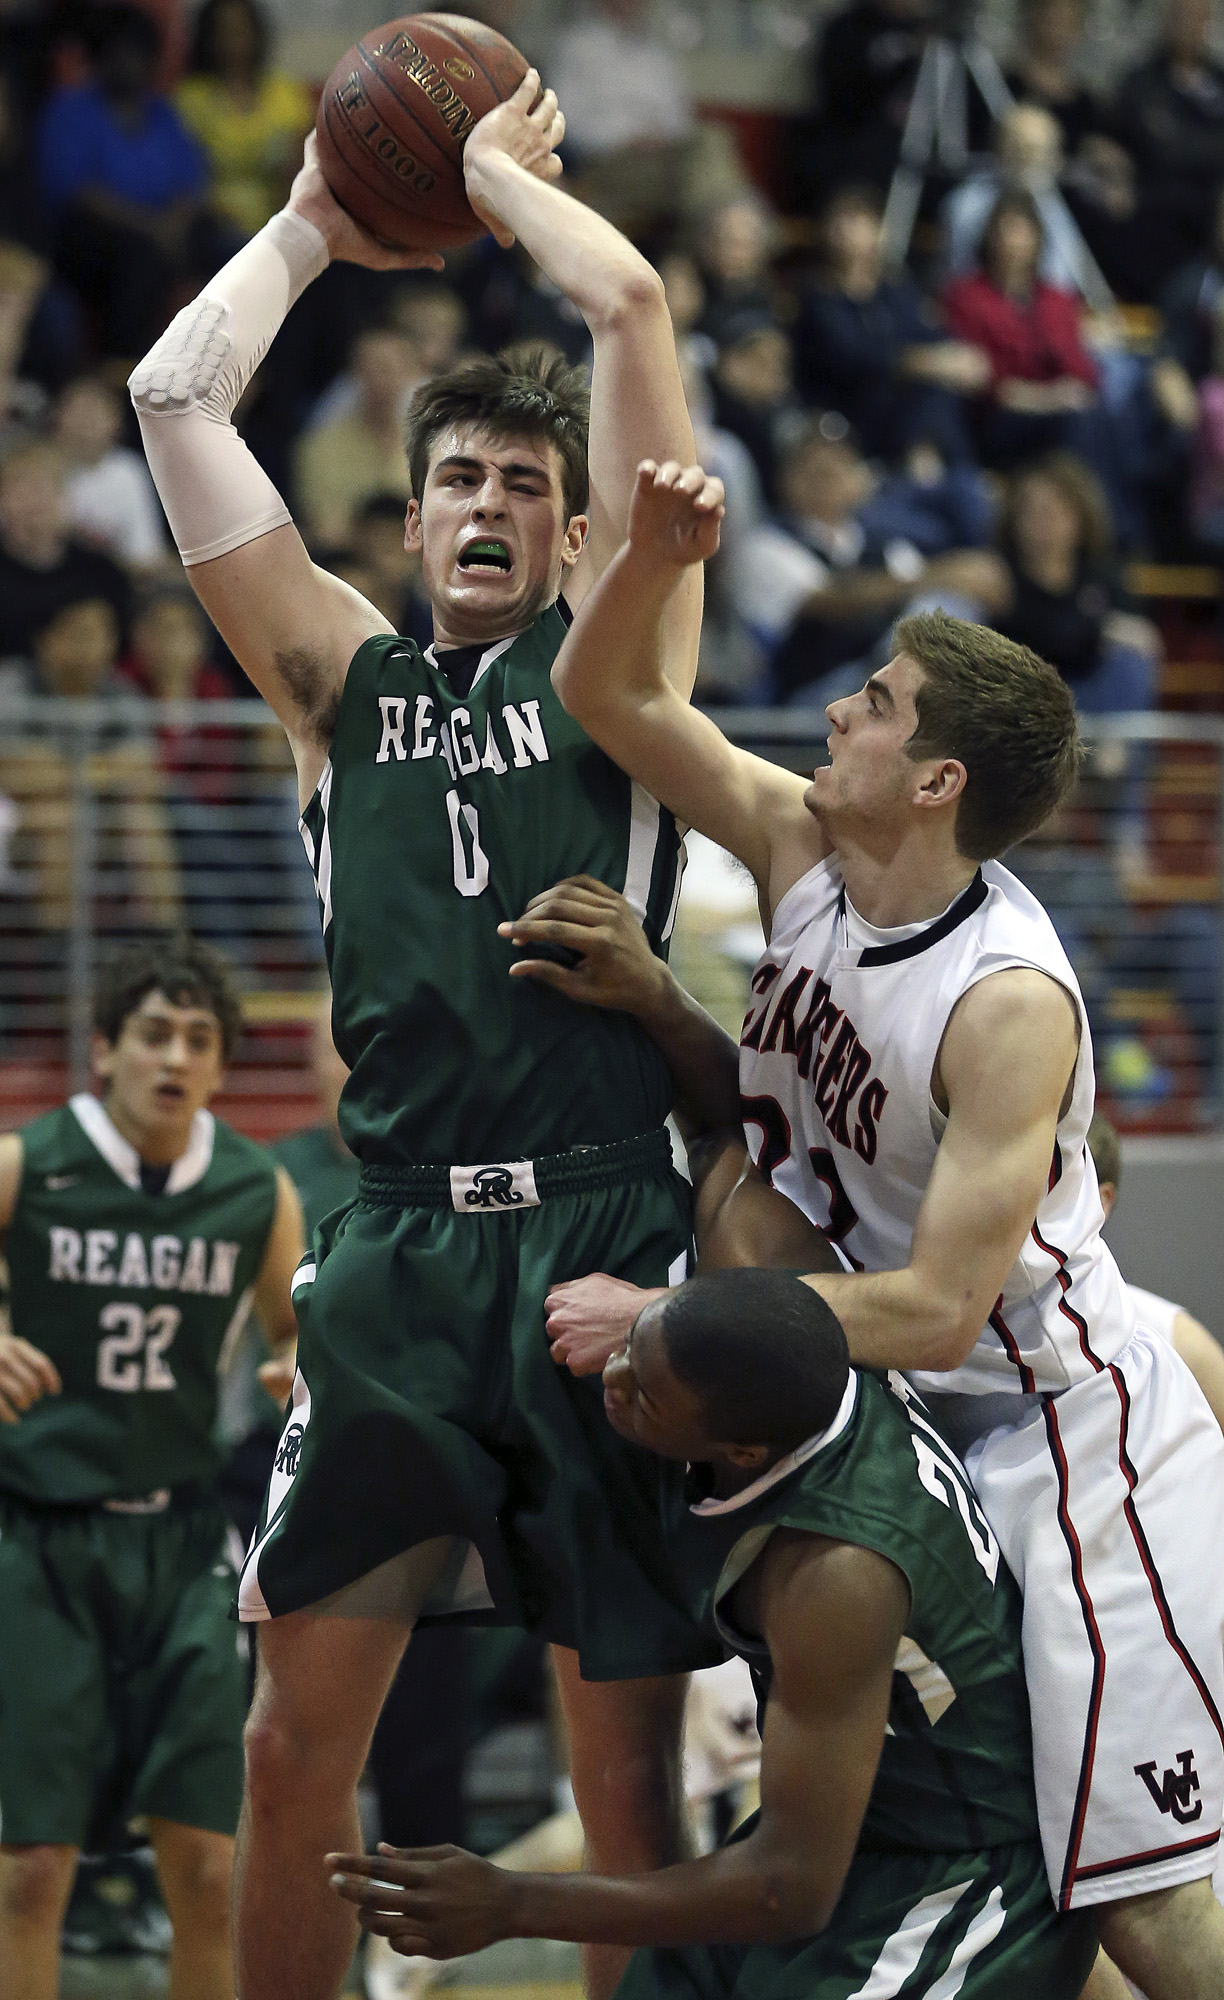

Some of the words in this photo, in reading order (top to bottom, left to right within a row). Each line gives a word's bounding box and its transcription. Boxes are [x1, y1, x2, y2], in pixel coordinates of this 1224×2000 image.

[373, 32, 478, 155] SPALDIN
[364, 121, 435, 193] 1000
[446, 788, 490, 897] 0
[49, 1226, 241, 1297] REAGAN
[96, 1302, 182, 1393] 22
